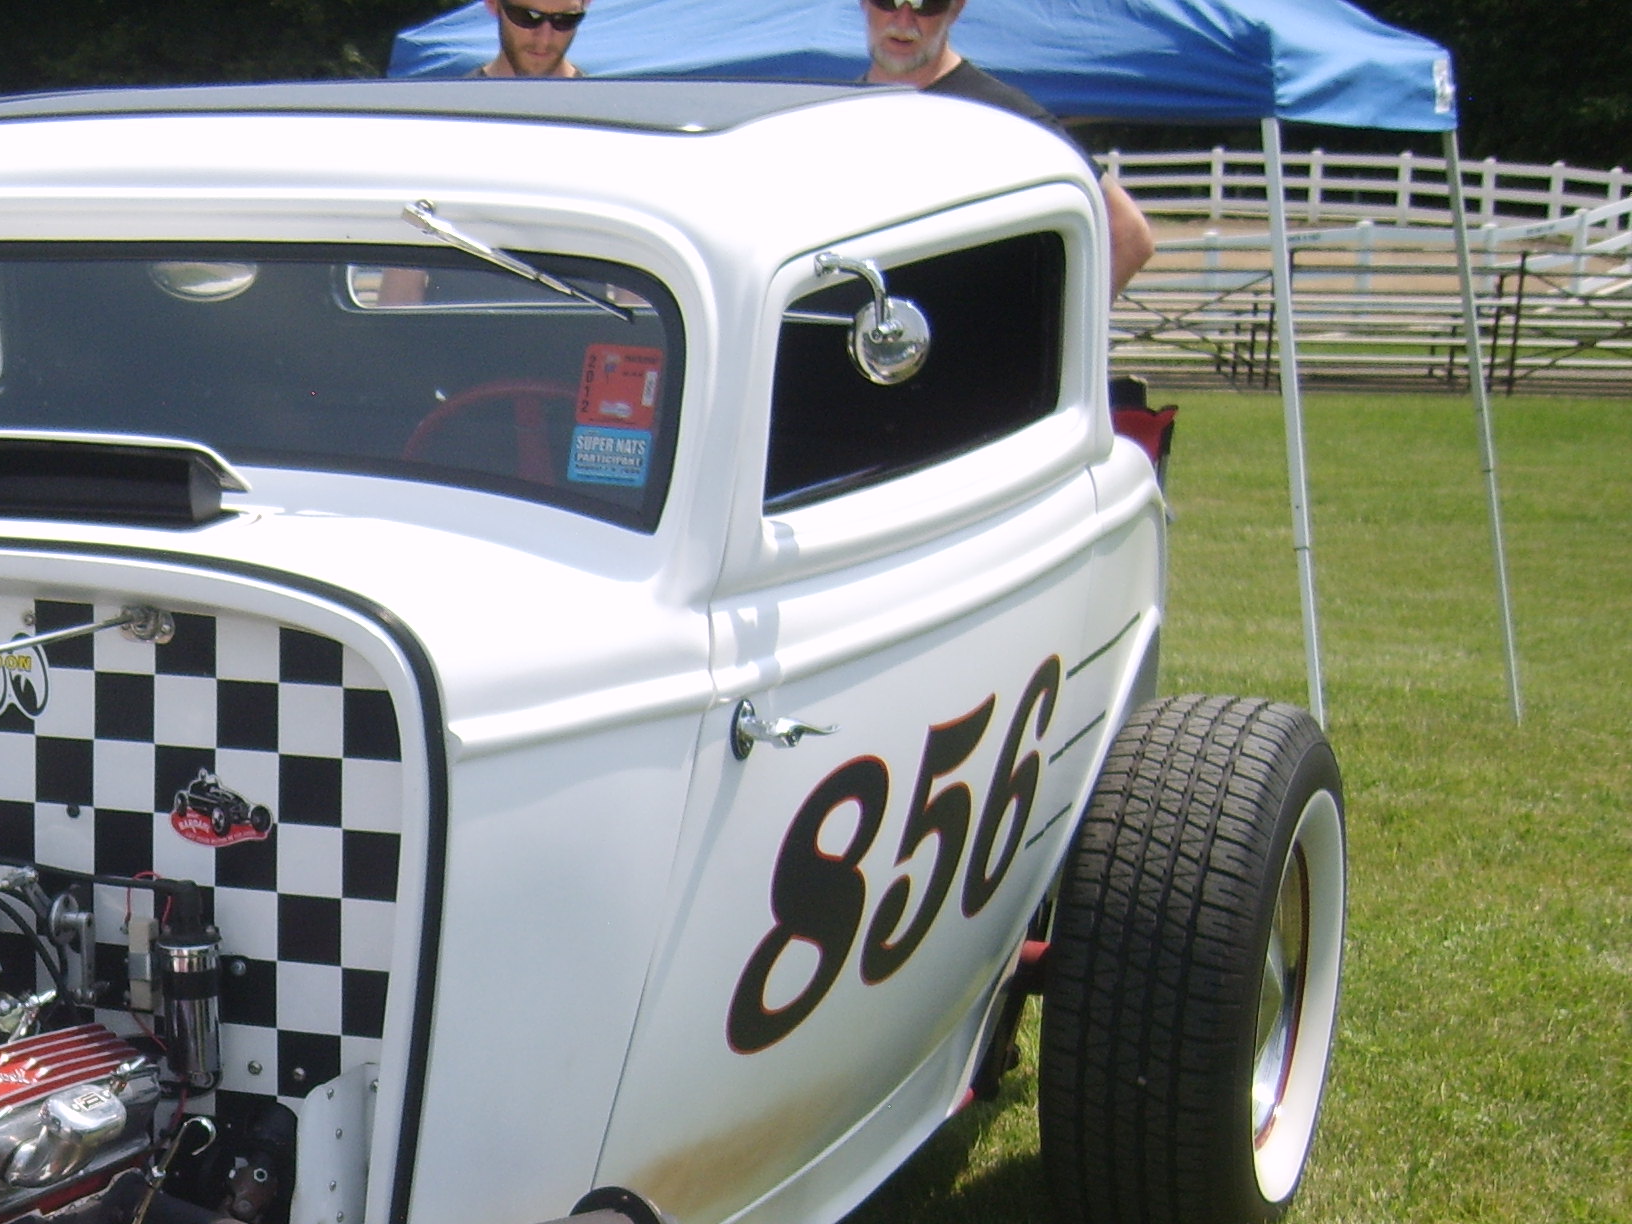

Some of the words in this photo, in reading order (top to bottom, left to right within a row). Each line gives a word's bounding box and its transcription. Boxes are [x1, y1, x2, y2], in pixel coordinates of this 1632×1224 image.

[576, 436, 614, 452] SUPER
[616, 438, 647, 455] NATS
[726, 654, 1061, 1055] 856
